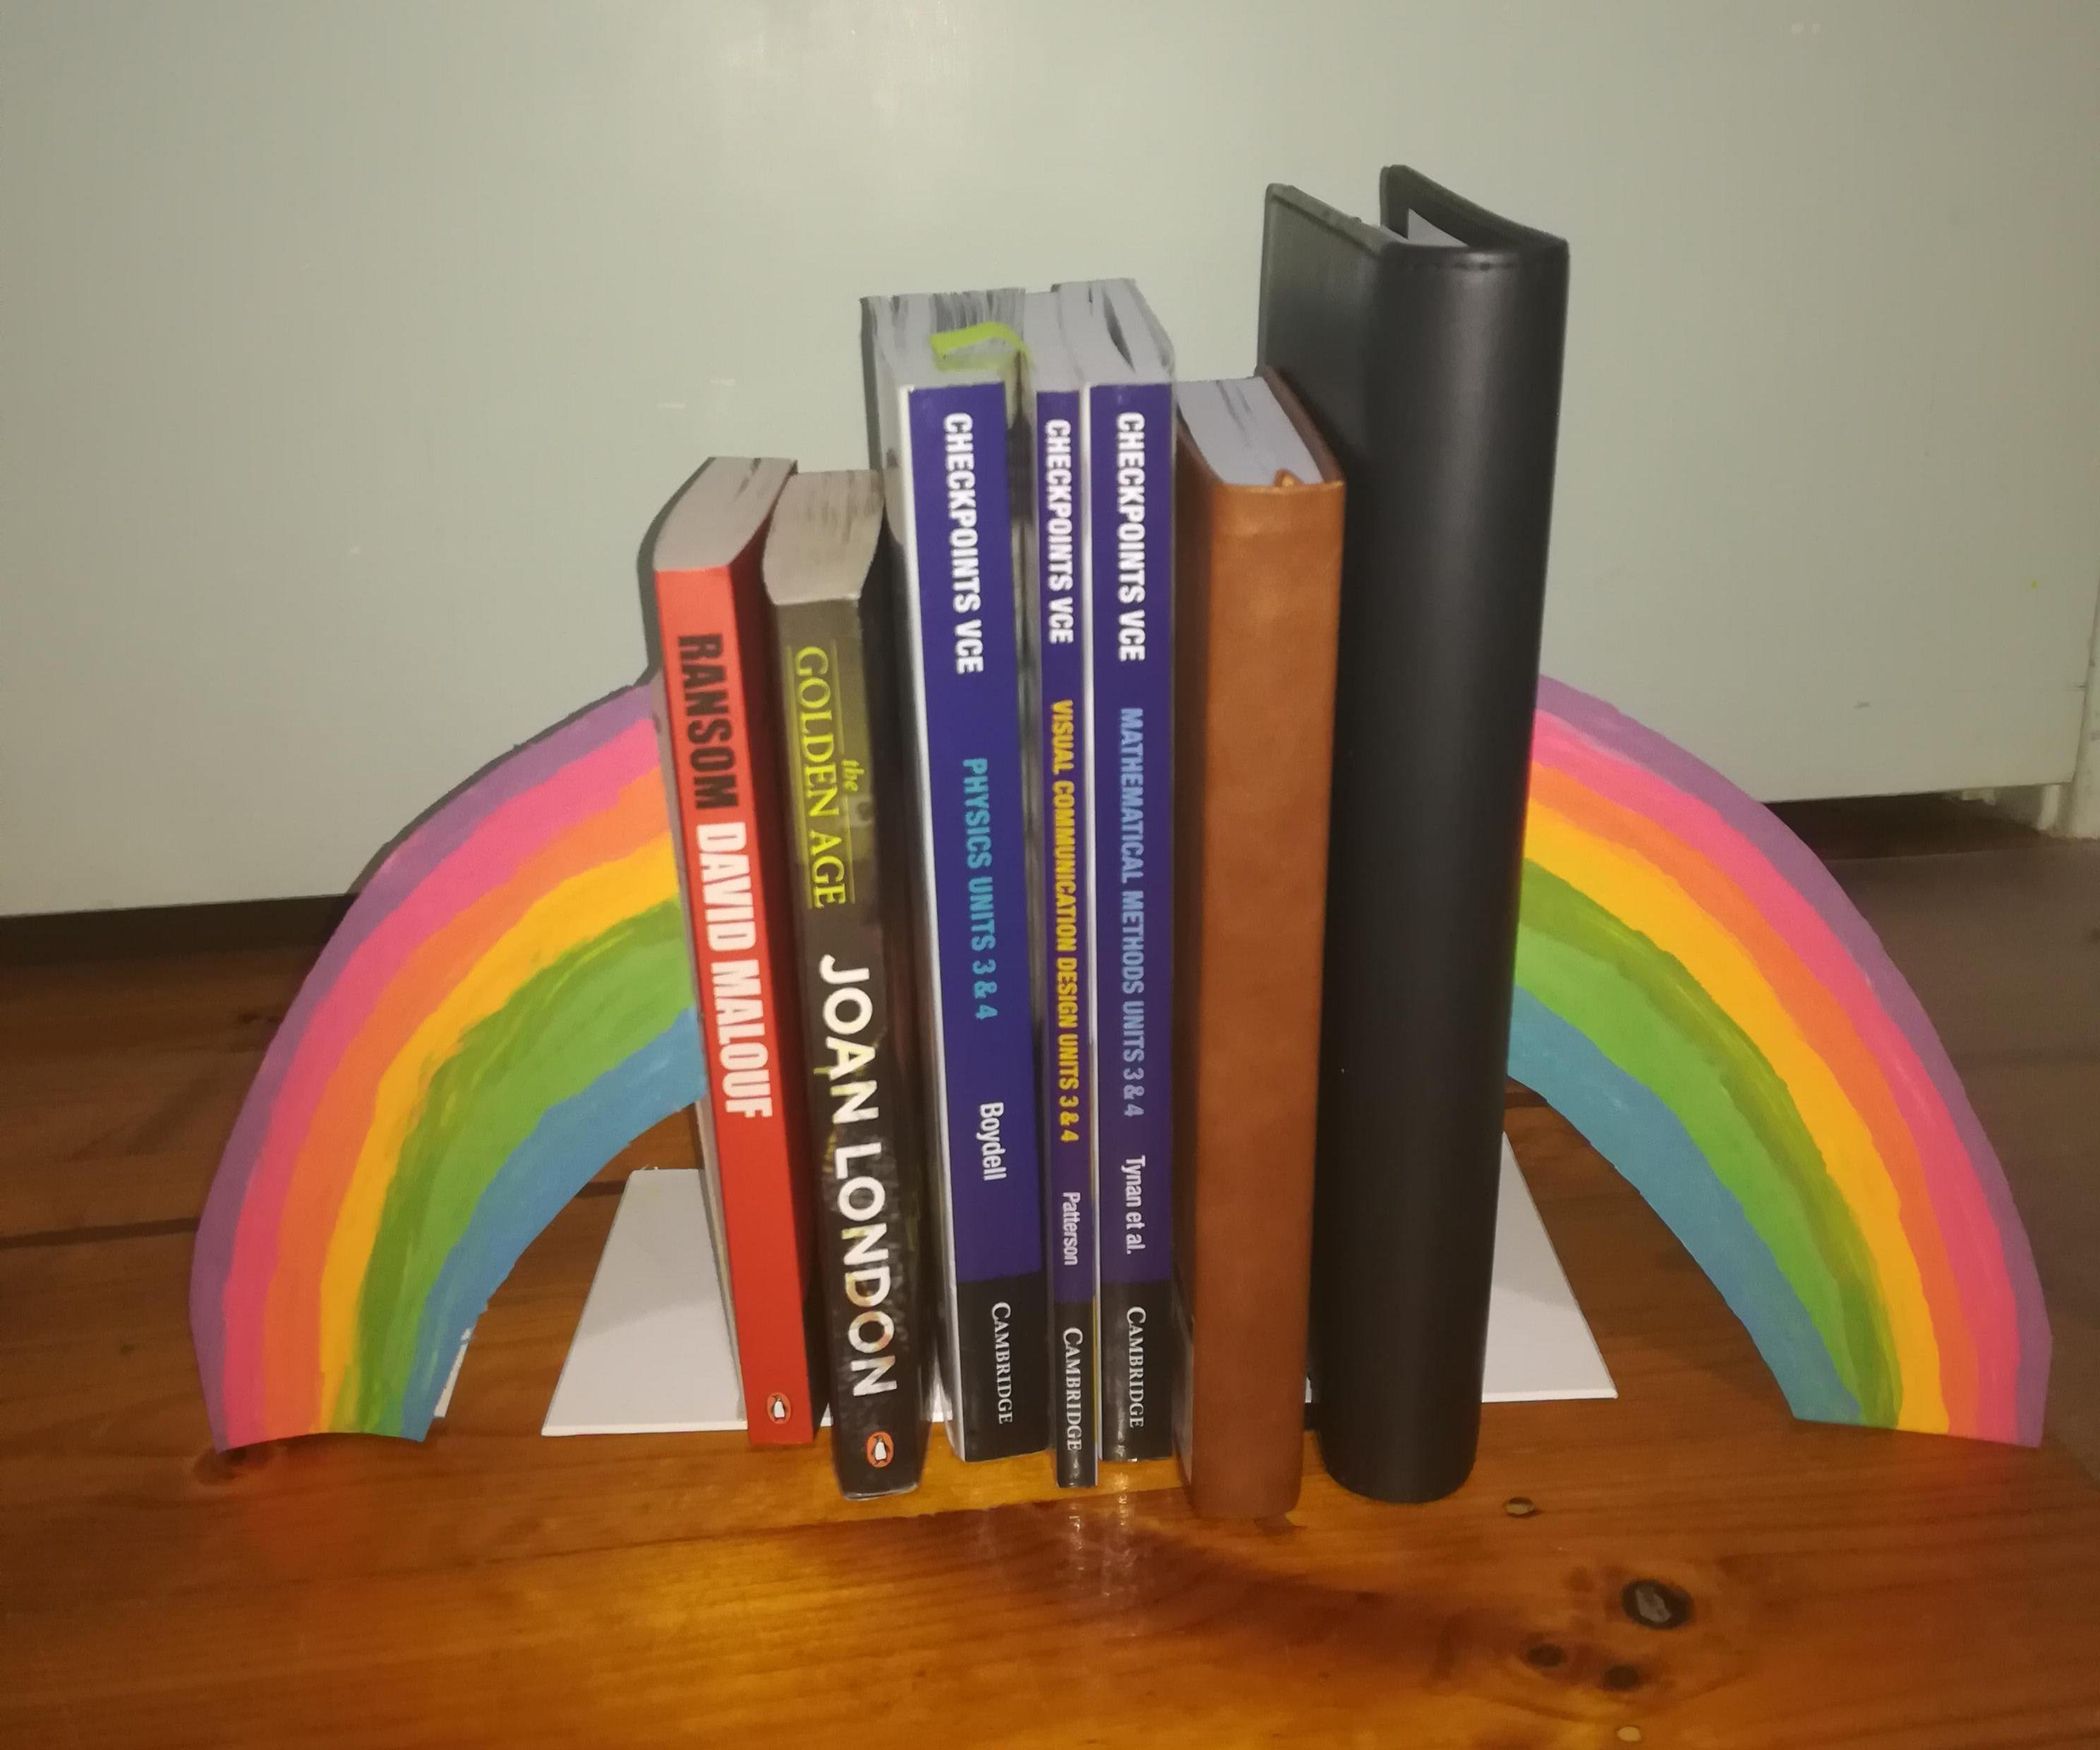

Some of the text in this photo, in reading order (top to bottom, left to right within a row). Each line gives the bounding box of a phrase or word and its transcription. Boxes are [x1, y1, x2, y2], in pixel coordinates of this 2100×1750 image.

[943, 411, 984, 674] CHECKPOINTS VCE
[1045, 419, 1074, 645] CHECKPOINTS VCE
[1116, 411, 1146, 662] CHECKPOINTS VCE
[677, 634, 738, 809] RANSOM
[795, 646, 846, 909] GOLDEN AGE
[841, 759, 865, 792] the
[695, 822, 773, 1118] DAVID MALOUF
[962, 758, 998, 1020] PHYSICS UNITS 3 & 4
[1051, 699, 1080, 1142] VISUAL COMMUNICATION DESIGN UNITS 3 & 4
[1120, 707, 1145, 1117] MATHEMATICAL METHODS UNITS 3 & 4
[818, 954, 897, 1397] JOAN LONDON
[976, 1102, 1007, 1181] Boydell
[1063, 1191, 1081, 1265] Patterson
[1121, 1155, 1146, 1255] Tynan et al.
[991, 1301, 1013, 1424] CAMBRIDGE
[1063, 1327, 1083, 1451] CAMBRIDGE
[1126, 1306, 1146, 1428] CAMBRIDGE
